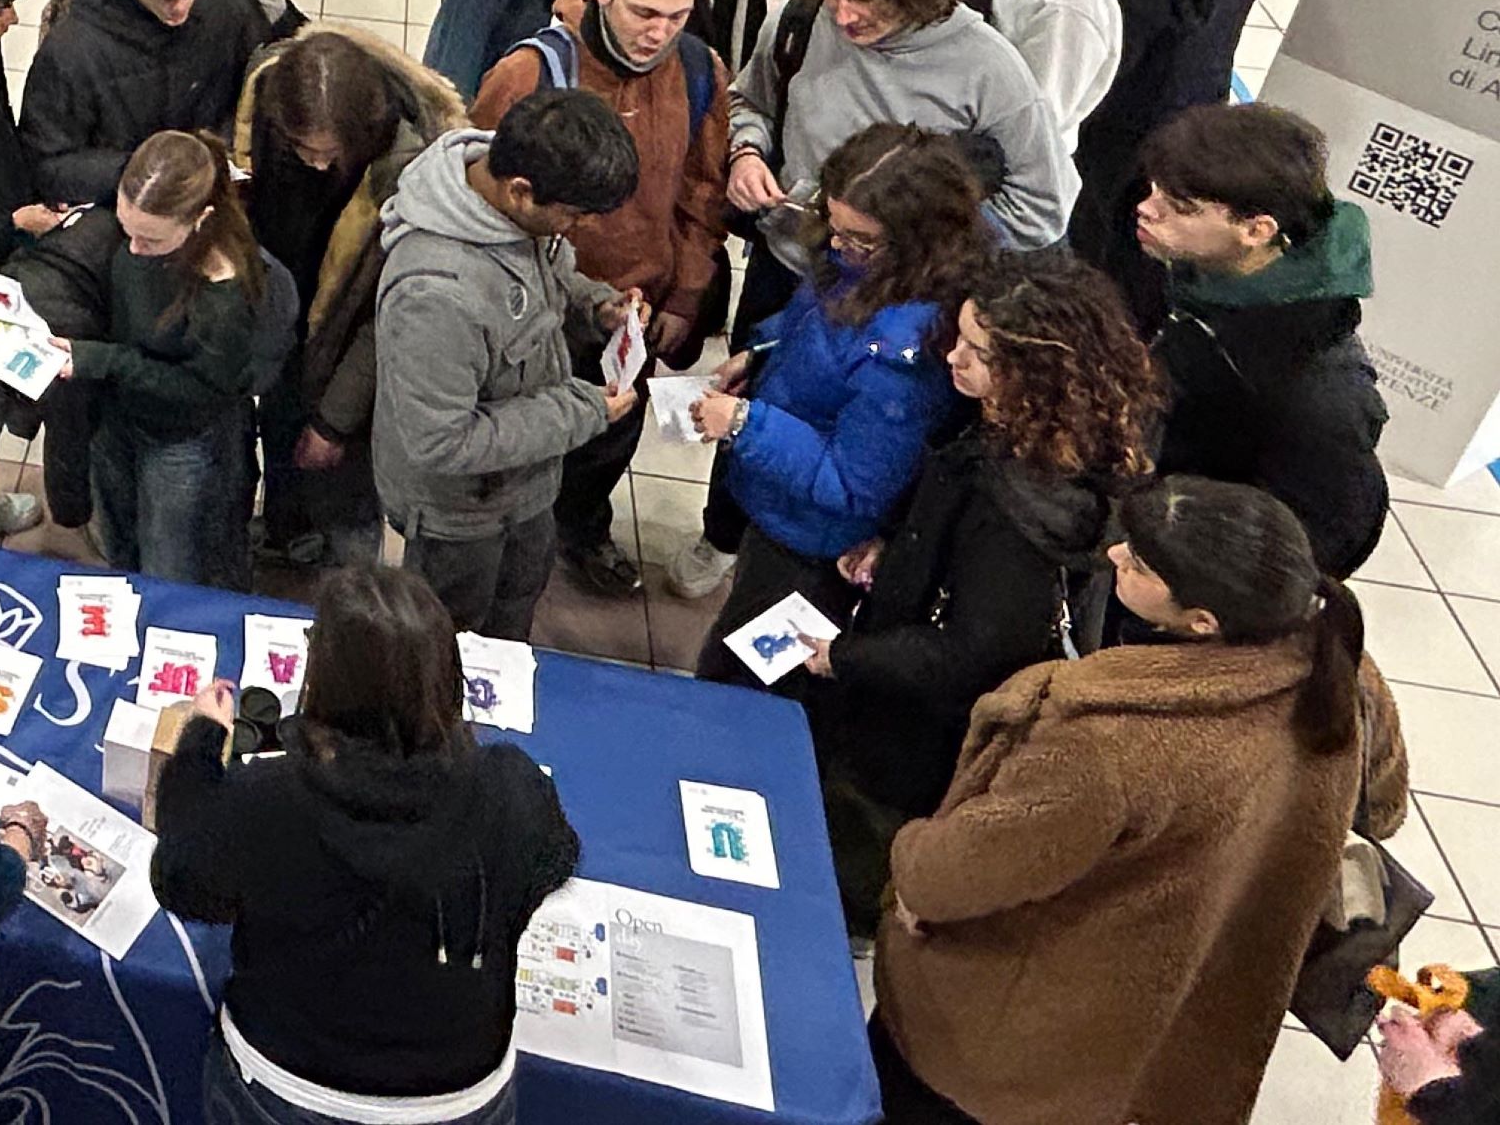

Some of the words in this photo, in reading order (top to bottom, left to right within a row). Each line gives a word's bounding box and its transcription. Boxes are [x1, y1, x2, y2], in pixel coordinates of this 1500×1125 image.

[1449, 69, 1477, 90] di
[1378, 372, 1447, 413] RENZE
[615, 908, 663, 934] Open
